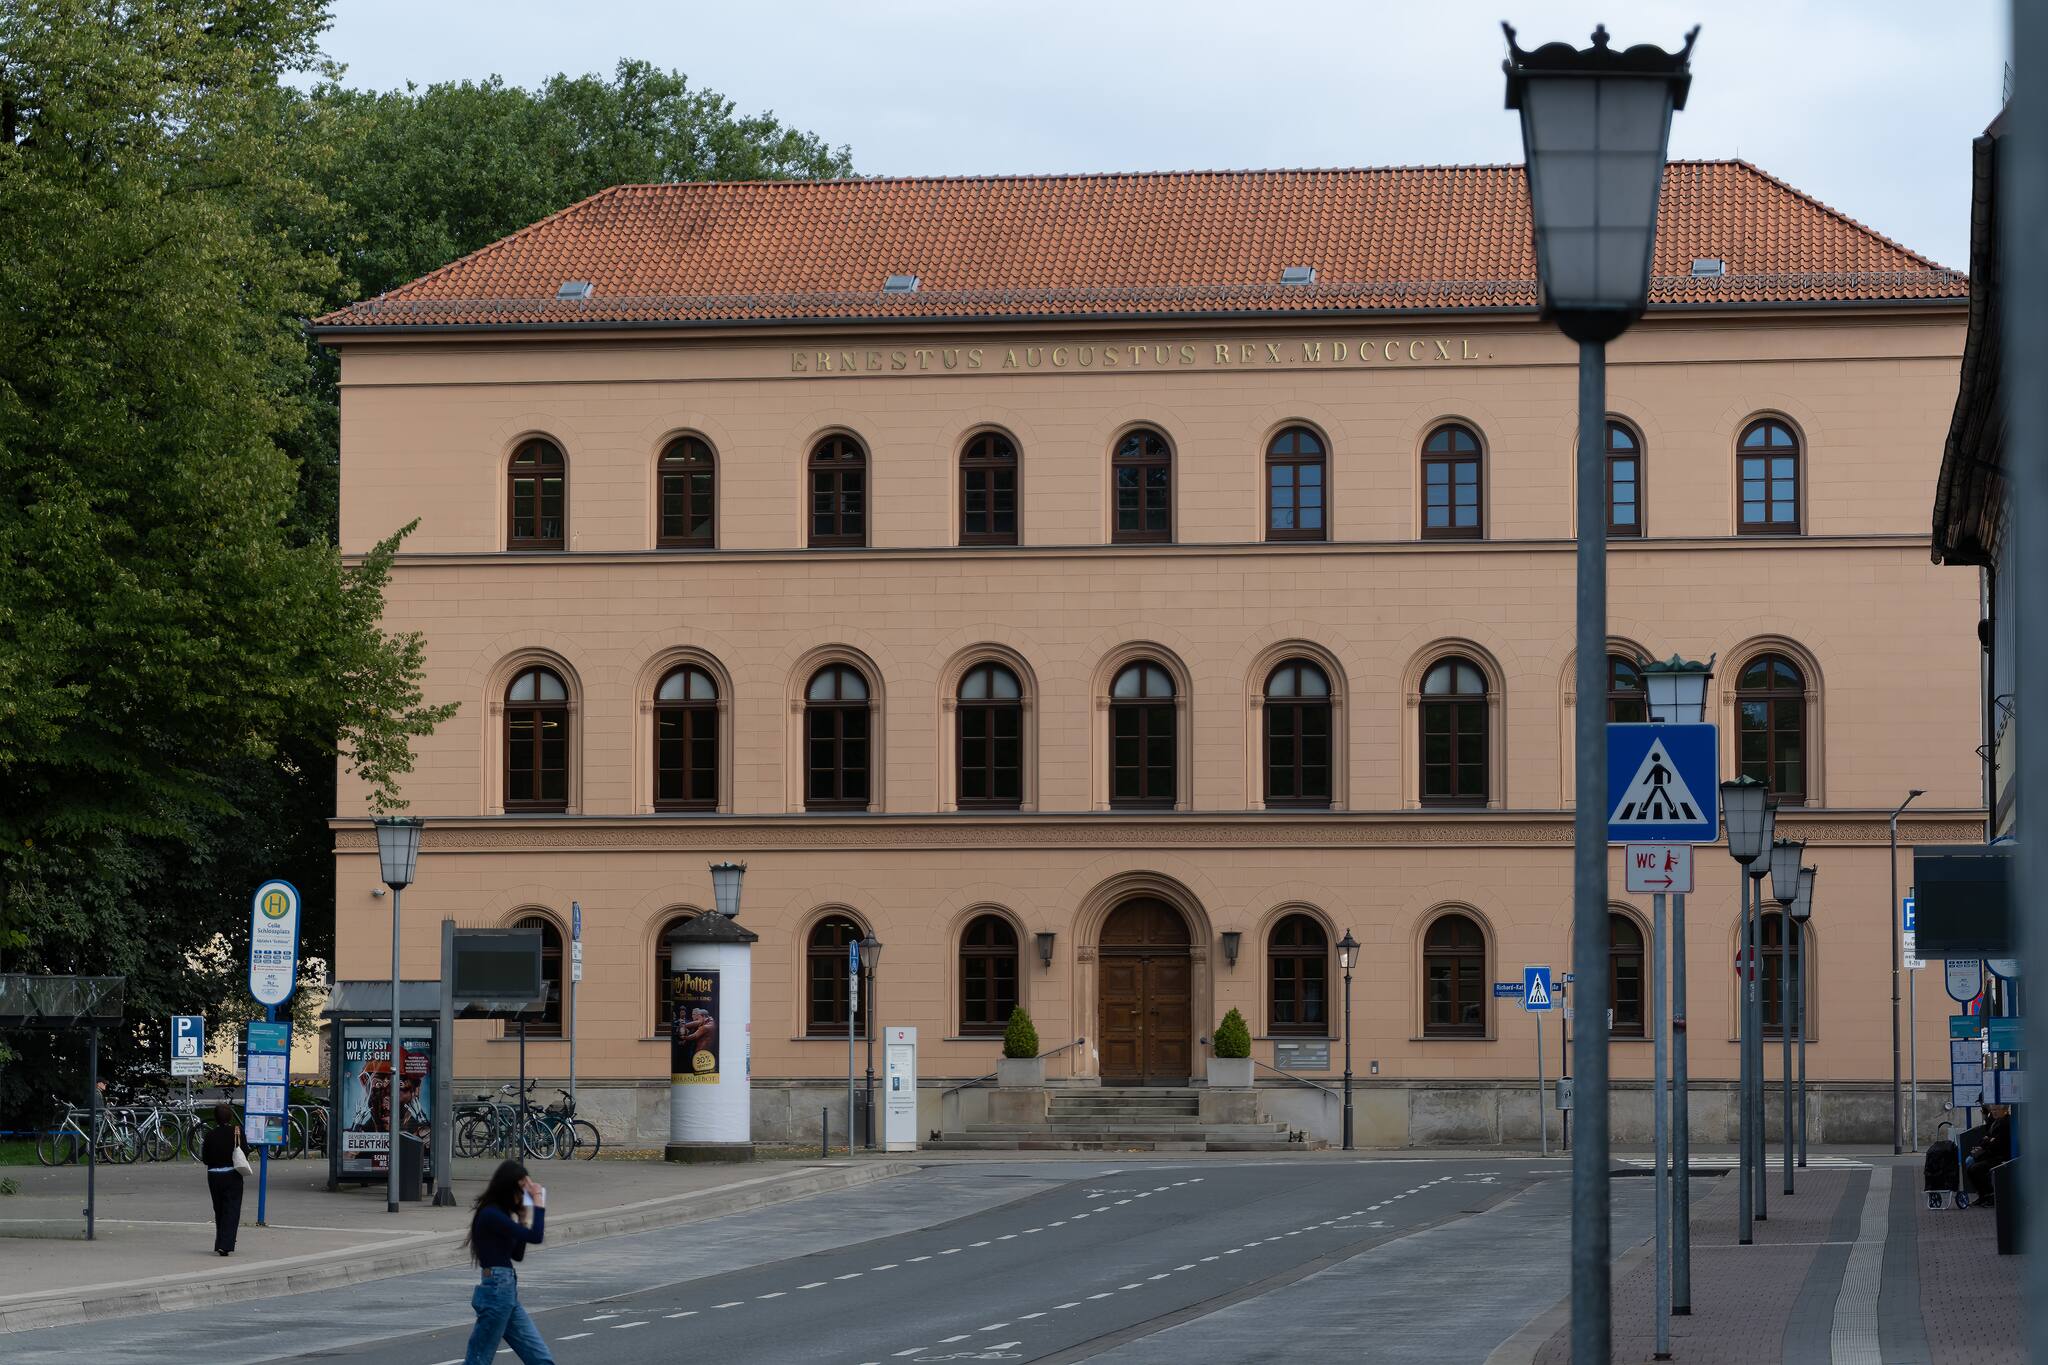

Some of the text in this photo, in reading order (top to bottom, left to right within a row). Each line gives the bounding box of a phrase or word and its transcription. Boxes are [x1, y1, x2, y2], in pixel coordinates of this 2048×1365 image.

[791, 349, 983, 372] ERNESTUS
[1002, 344, 1196, 368] AUGUSTUS
[1636, 853, 1656, 869] WC
[269, 895, 282, 913] H
[257, 927, 290, 935] Schlossplatz
[684, 973, 713, 993] Potter
[178, 1018, 192, 1037] P
[346, 1041, 387, 1050] DU WEISST
[346, 1051, 392, 1061] WIE ES GEH
[348, 1139, 390, 1149] ELEKTRIK
